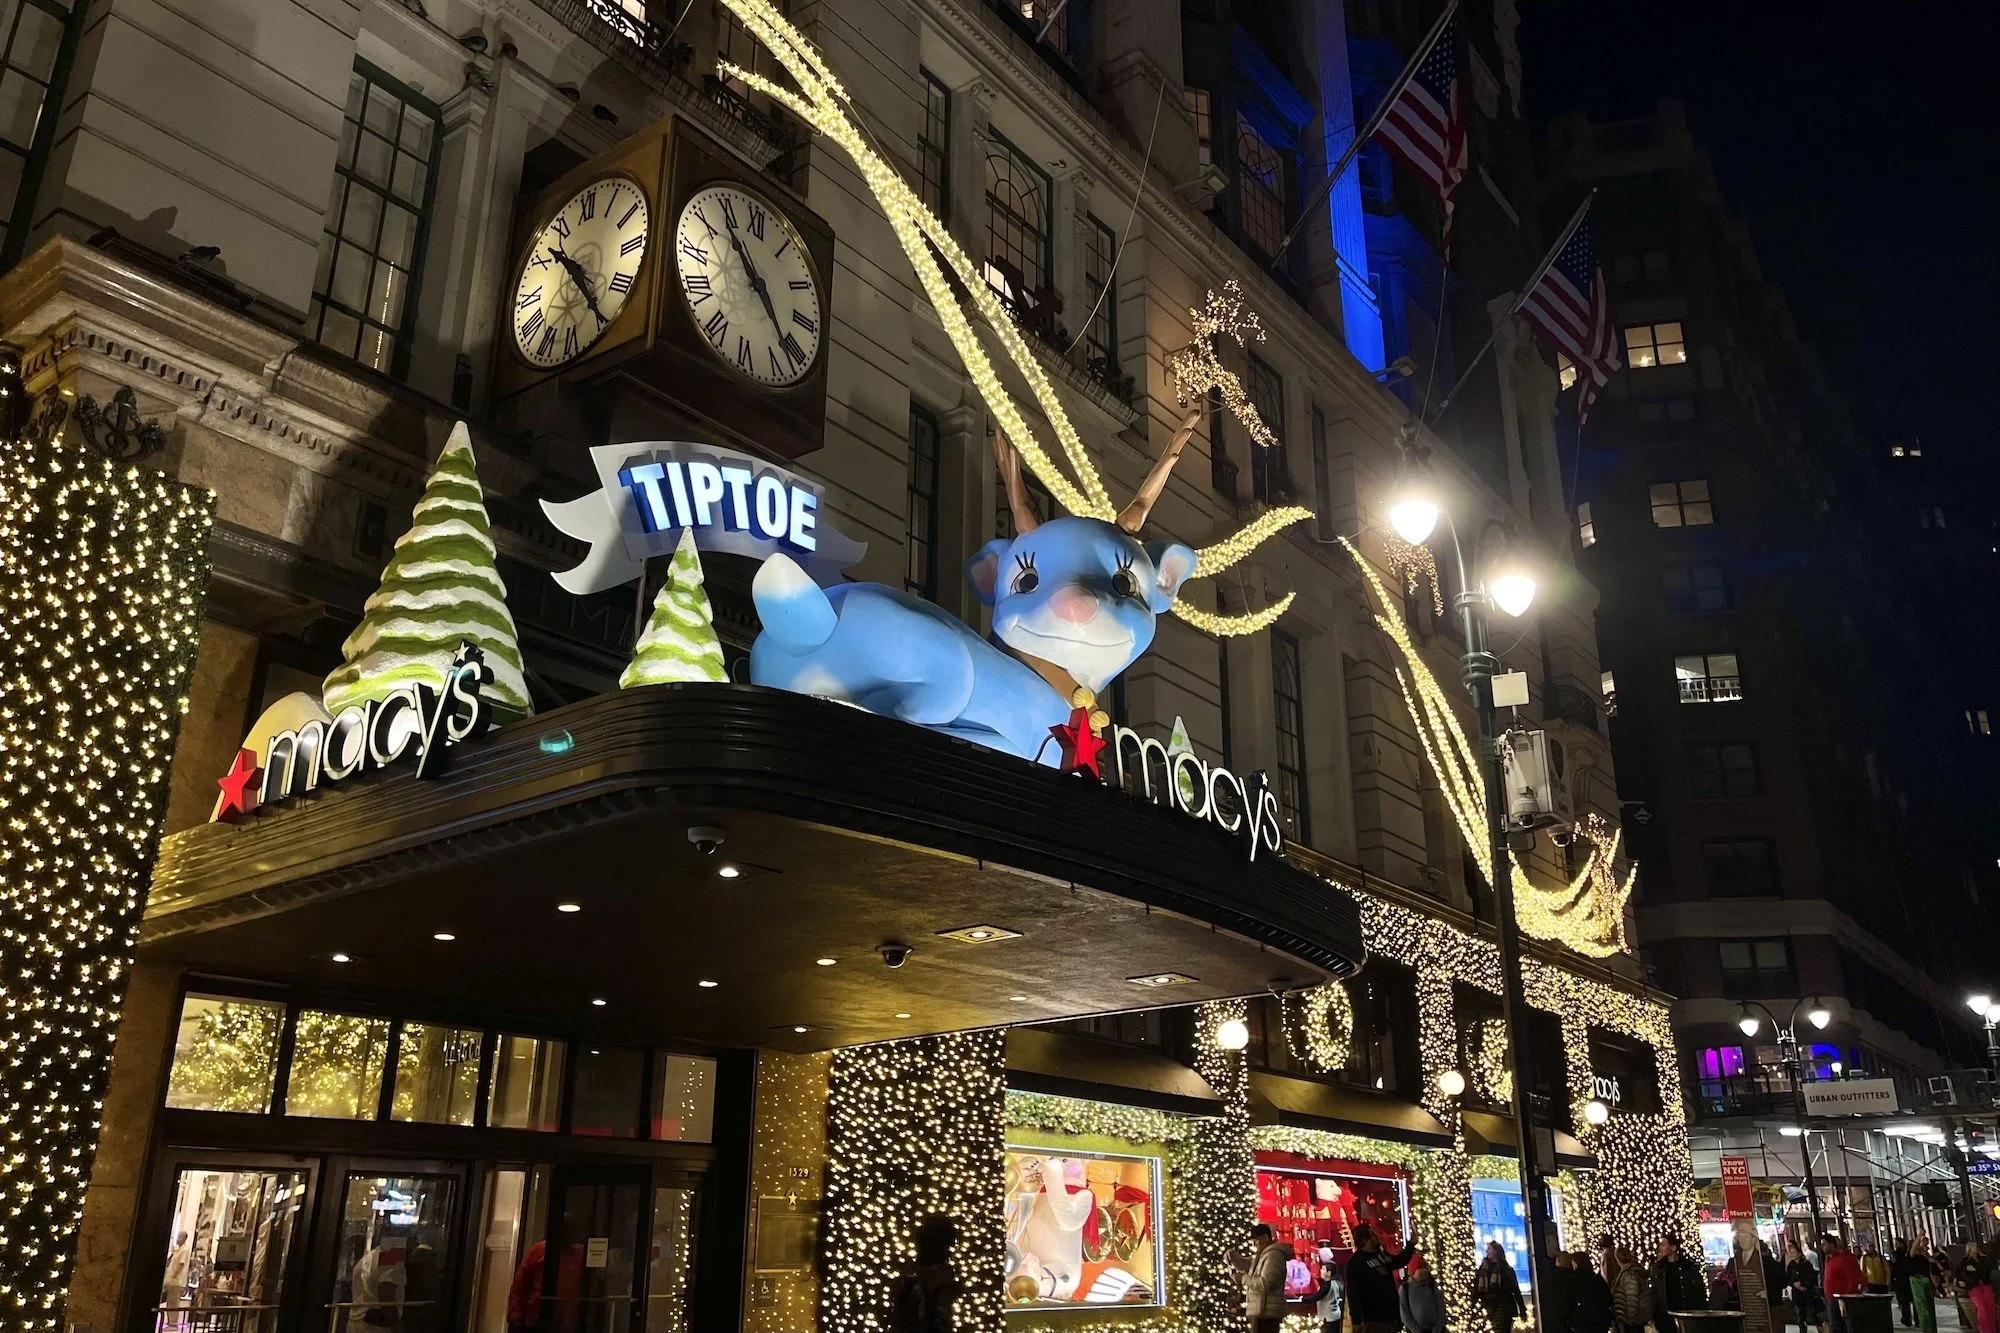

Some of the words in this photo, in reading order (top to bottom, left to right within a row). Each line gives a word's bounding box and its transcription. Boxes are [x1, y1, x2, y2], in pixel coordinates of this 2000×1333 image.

[620, 461, 817, 553] TIPTOE
[257, 641, 483, 804] macy's
[1113, 723, 1282, 863] macy's
[1809, 1094, 1838, 1103] URBAN
[1840, 1091, 1891, 1101] OUTFITTERS
[1721, 1159, 1745, 1167] know
[789, 1167, 809, 1178] 1329
[1722, 1166, 1746, 1175] NYC
